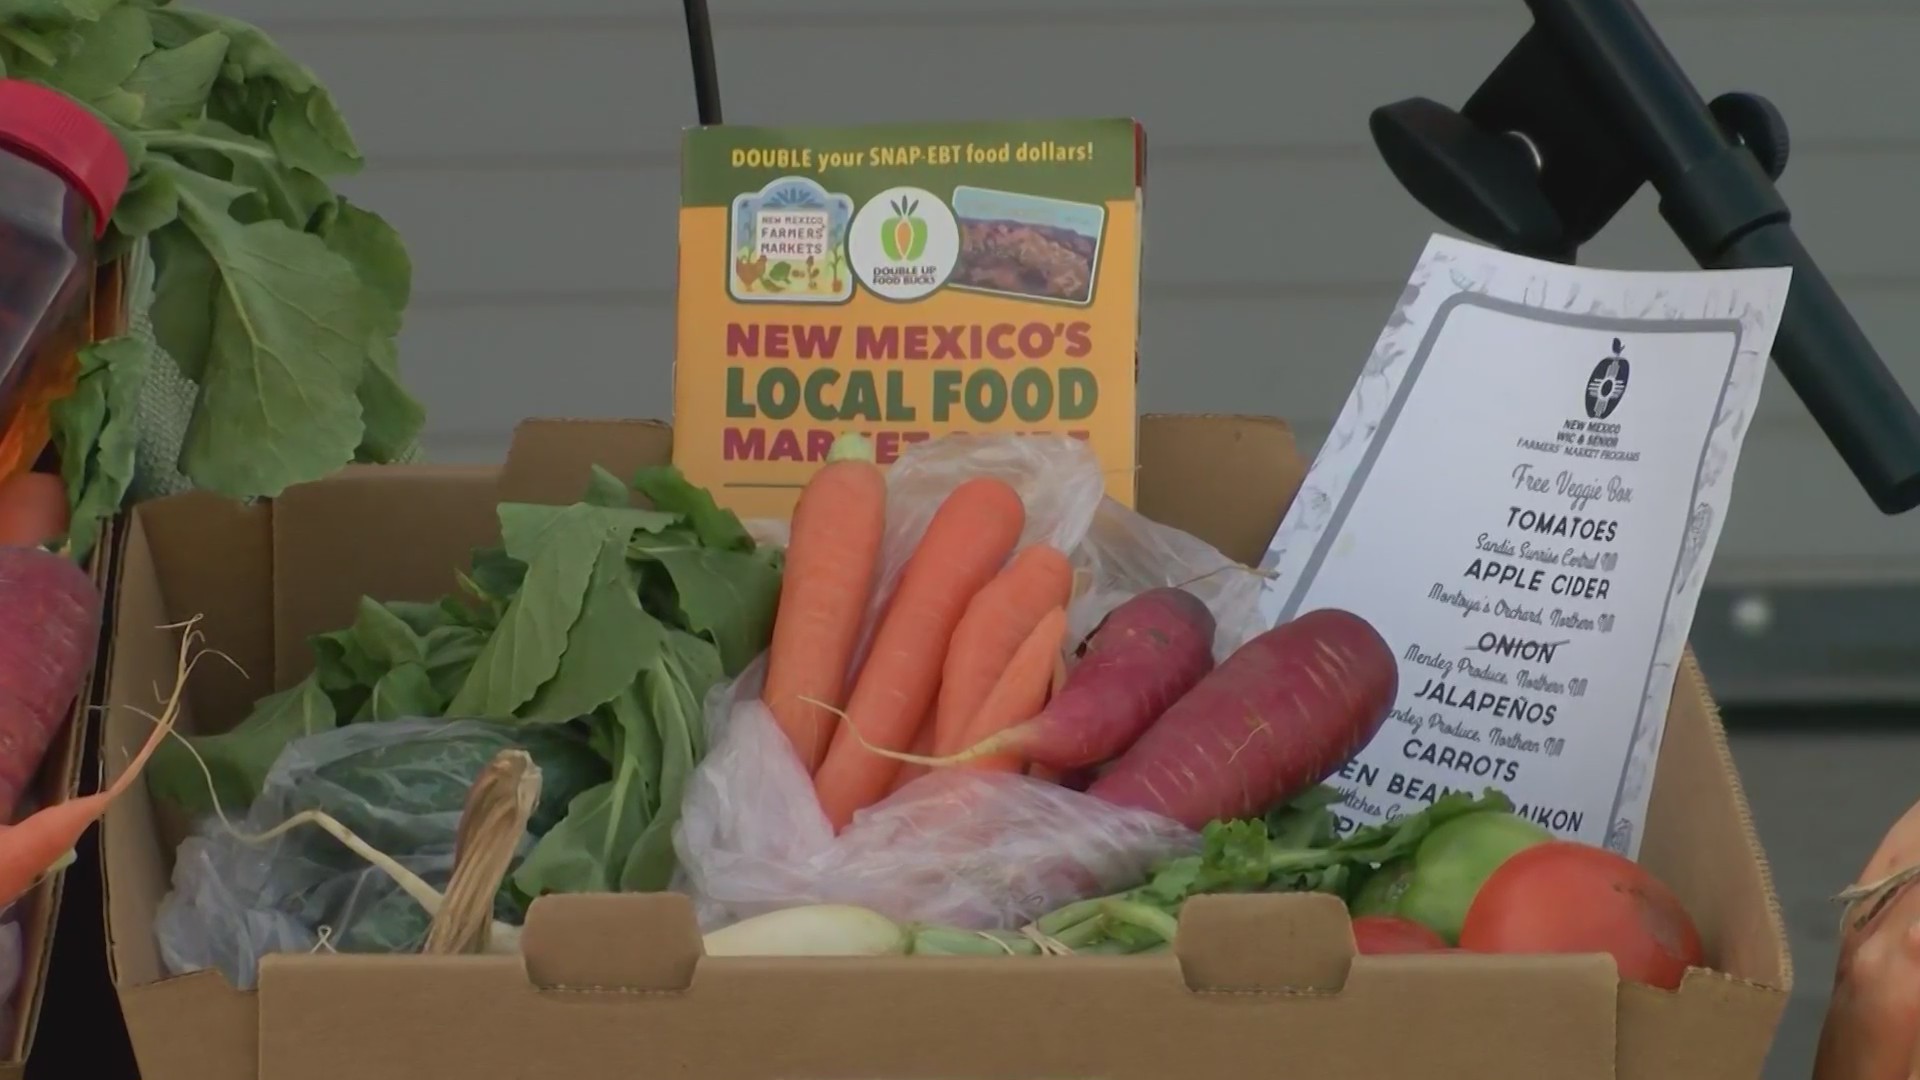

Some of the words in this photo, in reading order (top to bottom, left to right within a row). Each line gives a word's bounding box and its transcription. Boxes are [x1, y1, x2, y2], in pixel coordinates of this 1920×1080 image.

[732, 148, 811, 169] DOUBLE
[817, 151, 864, 173] your
[870, 144, 961, 166] SNAP-EBT
[966, 143, 1009, 164] food
[1016, 142, 1094, 162] dollars!
[762, 216, 781, 225] NEW
[785, 216, 823, 225] MEXICO
[761, 243, 822, 255] MARKETS
[872, 275, 901, 285] FOOD
[904, 275, 936, 284] BUCKS
[873, 266, 917, 275] DOUBLE
[921, 265, 937, 275] UP
[725, 323, 843, 359] NEW
[855, 322, 1092, 360] MEXICO'S
[725, 367, 916, 421] LOCAL
[932, 367, 1099, 423] FOOD
[1557, 431, 1576, 444] WIC
[1577, 434, 1585, 445] &
[1587, 434, 1619, 448] SENIOR
[1563, 419, 1586, 431] NEW
[1587, 421, 1621, 434] MEXICO
[724, 427, 930, 465] MARE
[1564, 446, 1600, 459] MARKET
[1512, 463, 1549, 493] Free
[1556, 470, 1602, 511] Veggie
[1607, 475, 1634, 503] Box
[1507, 507, 1618, 542] TOMATOES
[1464, 558, 1545, 591] APPLE
[1551, 574, 1610, 600] CIDER
[1478, 632, 1558, 664] ONION
[1404, 643, 1453, 679] Mendez
[1517, 669, 1564, 694] Northern
[1414, 678, 1557, 726] JALAPEÑOS
[1489, 727, 1539, 753] Northern
[1402, 738, 1519, 782] CARROTS
[1386, 772, 1473, 806] BEA
[1511, 803, 1583, 832] AIKON
